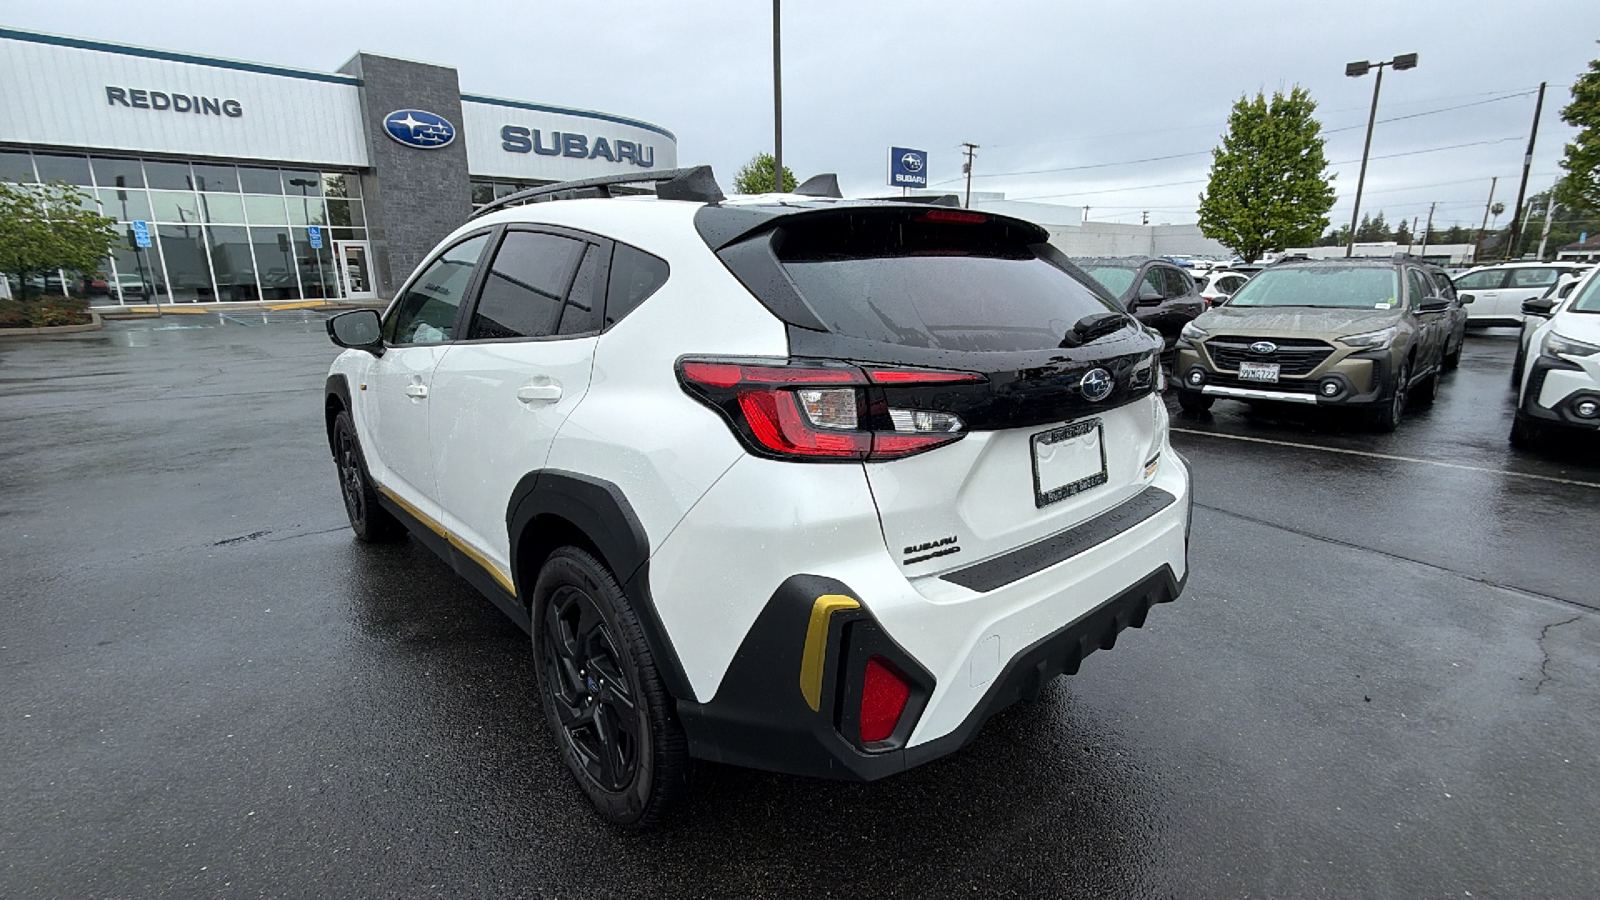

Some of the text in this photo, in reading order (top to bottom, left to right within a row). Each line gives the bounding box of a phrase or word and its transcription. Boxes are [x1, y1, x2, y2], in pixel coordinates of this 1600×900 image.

[105, 86, 243, 118] REDDING
[501, 125, 654, 168] SUBARU
[895, 173, 926, 184] SUBARU
[903, 535, 958, 555] SUBARU
